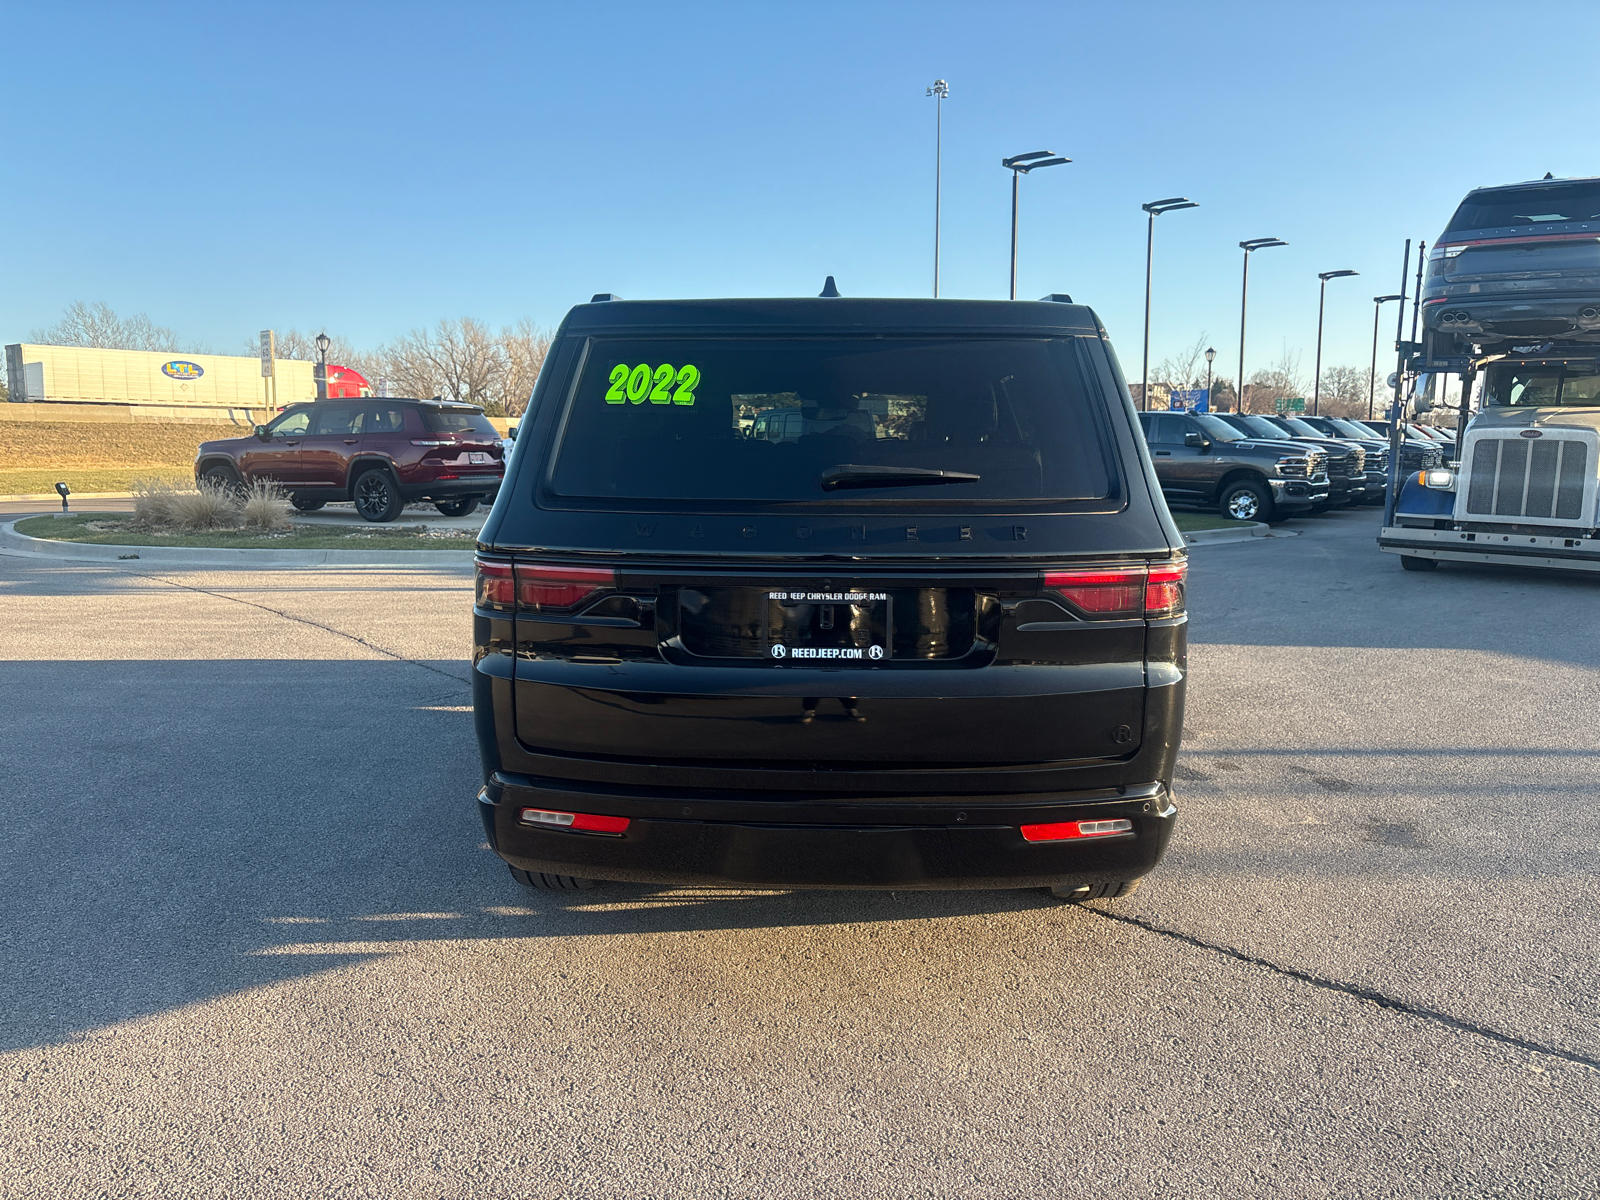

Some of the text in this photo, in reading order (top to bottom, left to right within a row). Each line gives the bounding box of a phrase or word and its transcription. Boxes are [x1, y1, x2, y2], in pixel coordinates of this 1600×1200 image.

[1479, 224, 1588, 235] LINCOLN
[166, 363, 198, 374] LTL
[605, 363, 701, 406] 2022
[634, 523, 1028, 541] WAGONEER
[769, 592, 787, 600] REED
[807, 592, 842, 600] CHRYSLER
[844, 592, 868, 600] DODGE
[869, 592, 886, 600] RAM
[791, 648, 862, 659] REEDJEEP.COM
